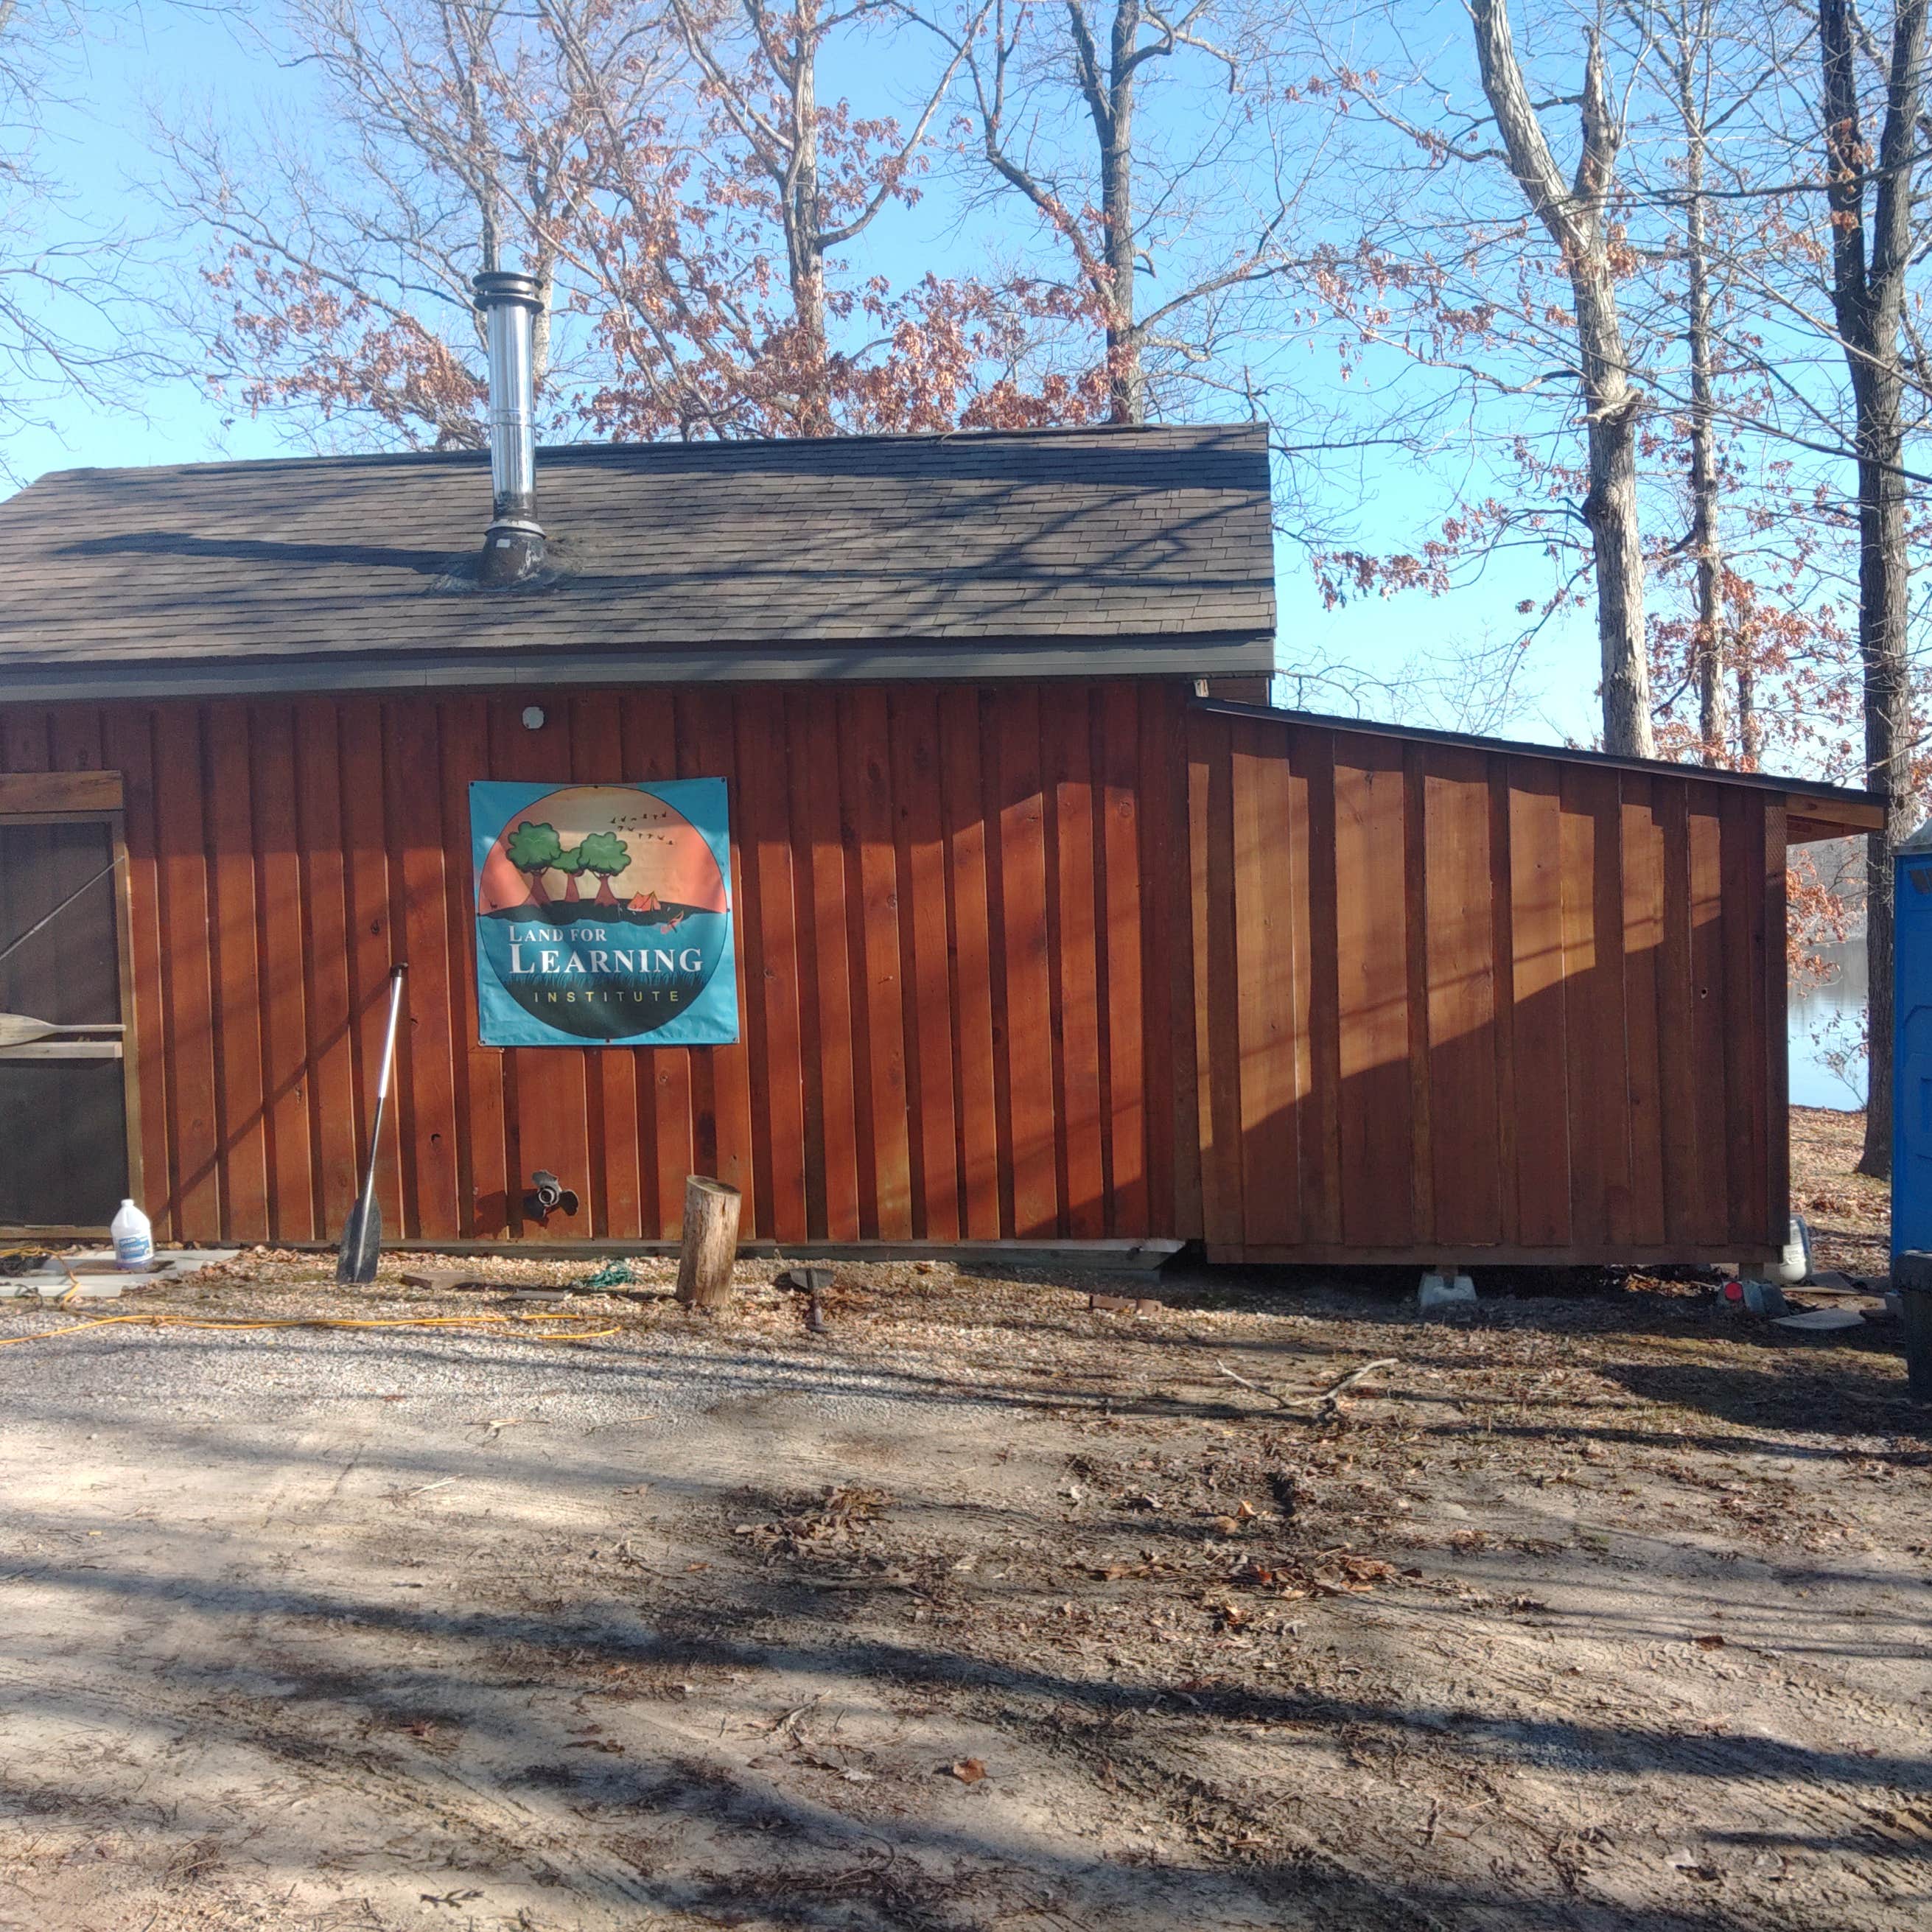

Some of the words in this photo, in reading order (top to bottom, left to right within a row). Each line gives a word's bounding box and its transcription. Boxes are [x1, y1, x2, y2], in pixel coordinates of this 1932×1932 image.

[509, 925, 563, 942] LAND
[571, 928, 607, 942] FOR
[508, 943, 703, 973] LEARNING
[534, 991, 679, 1002] INSTITUTE
